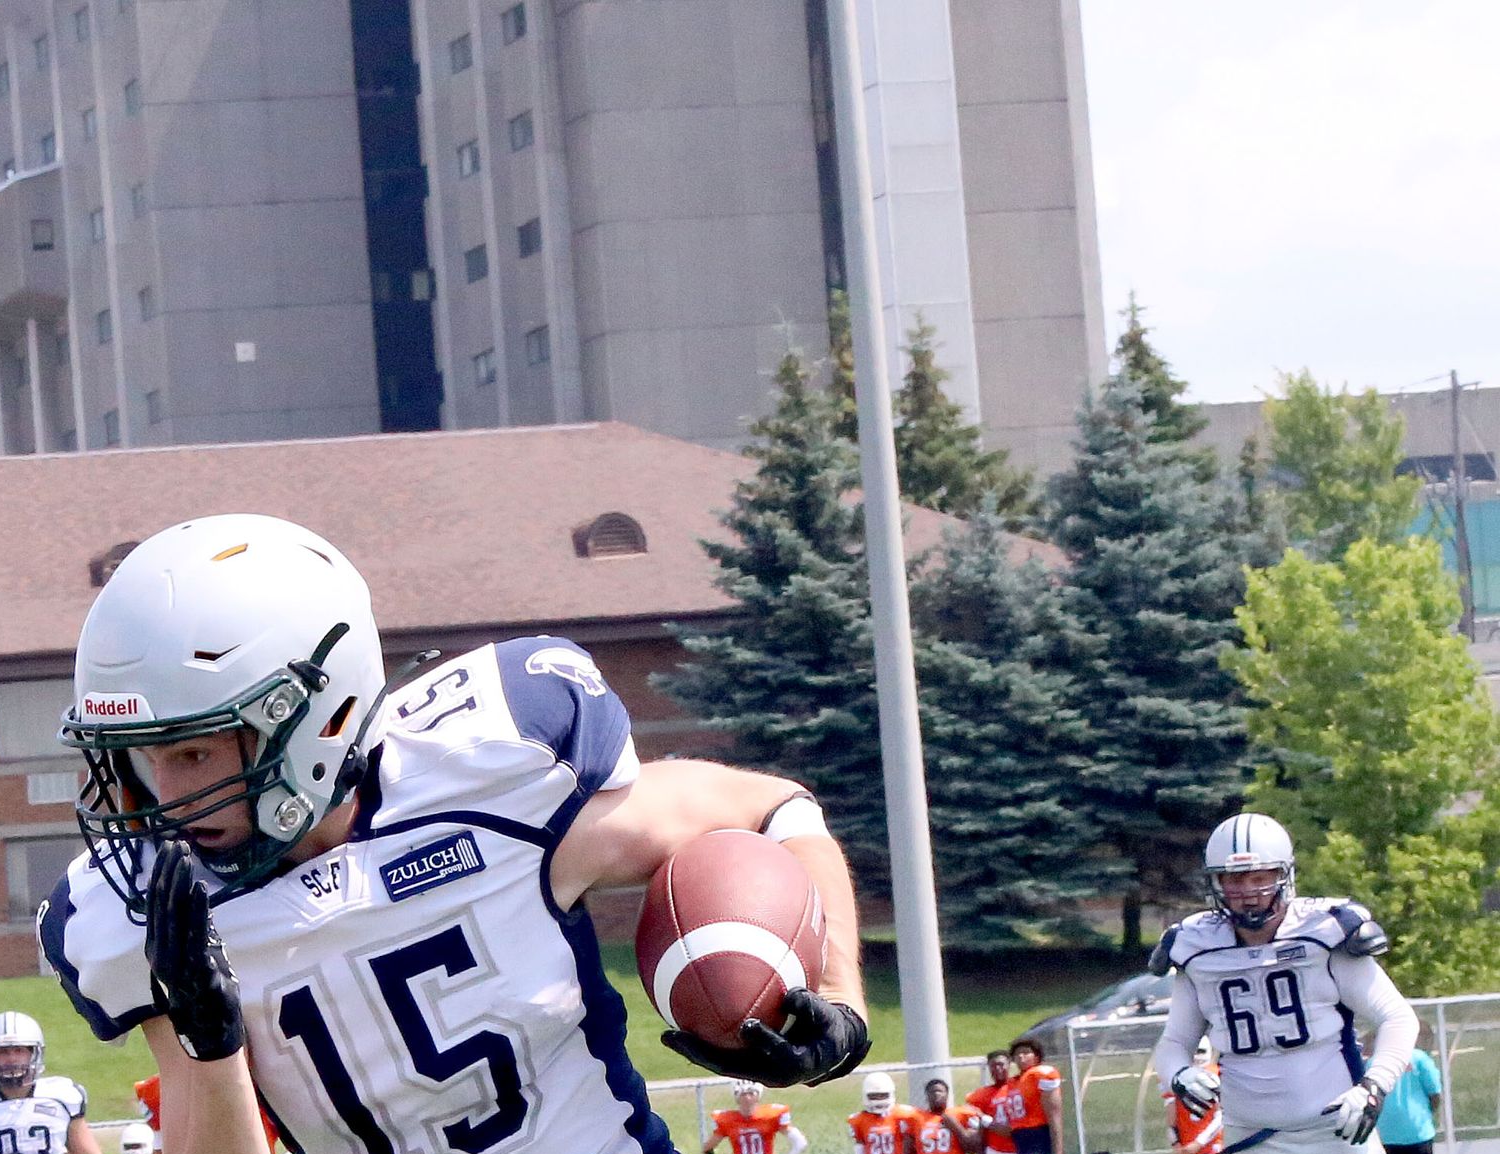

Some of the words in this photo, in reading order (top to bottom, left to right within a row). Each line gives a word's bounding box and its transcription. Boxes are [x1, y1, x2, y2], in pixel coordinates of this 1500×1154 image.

[85, 699, 138, 715] Riddell
[387, 847, 458, 885] ZULICH
[439, 863, 463, 878] group
[1220, 969, 1310, 1055] 69
